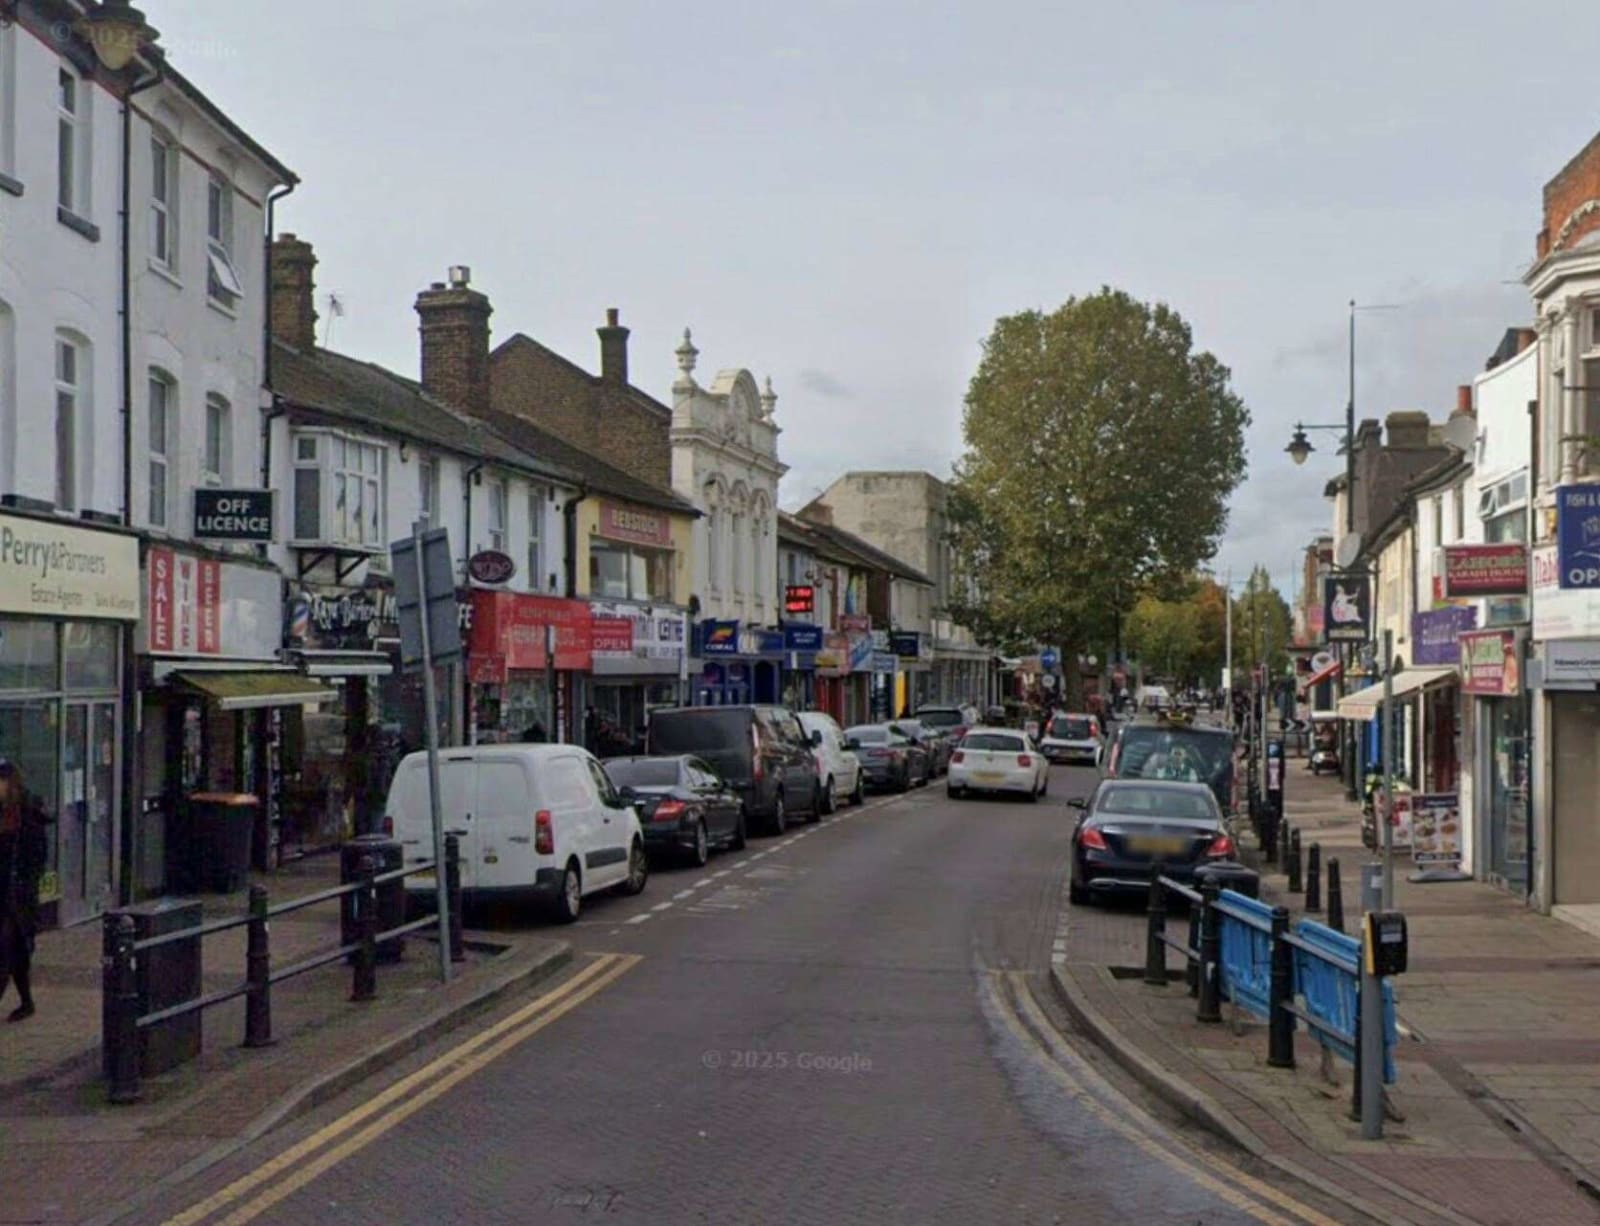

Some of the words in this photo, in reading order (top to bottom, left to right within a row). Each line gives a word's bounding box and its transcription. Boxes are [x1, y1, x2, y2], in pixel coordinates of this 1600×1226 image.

[216, 499, 250, 513] OFF
[198, 516, 269, 532] LICENCE
[1569, 568, 1600, 585] OP
[155, 559, 168, 645] SALE
[180, 560, 190, 647] WINE
[204, 565, 214, 647] BEER
[594, 639, 629, 649] OPEN
